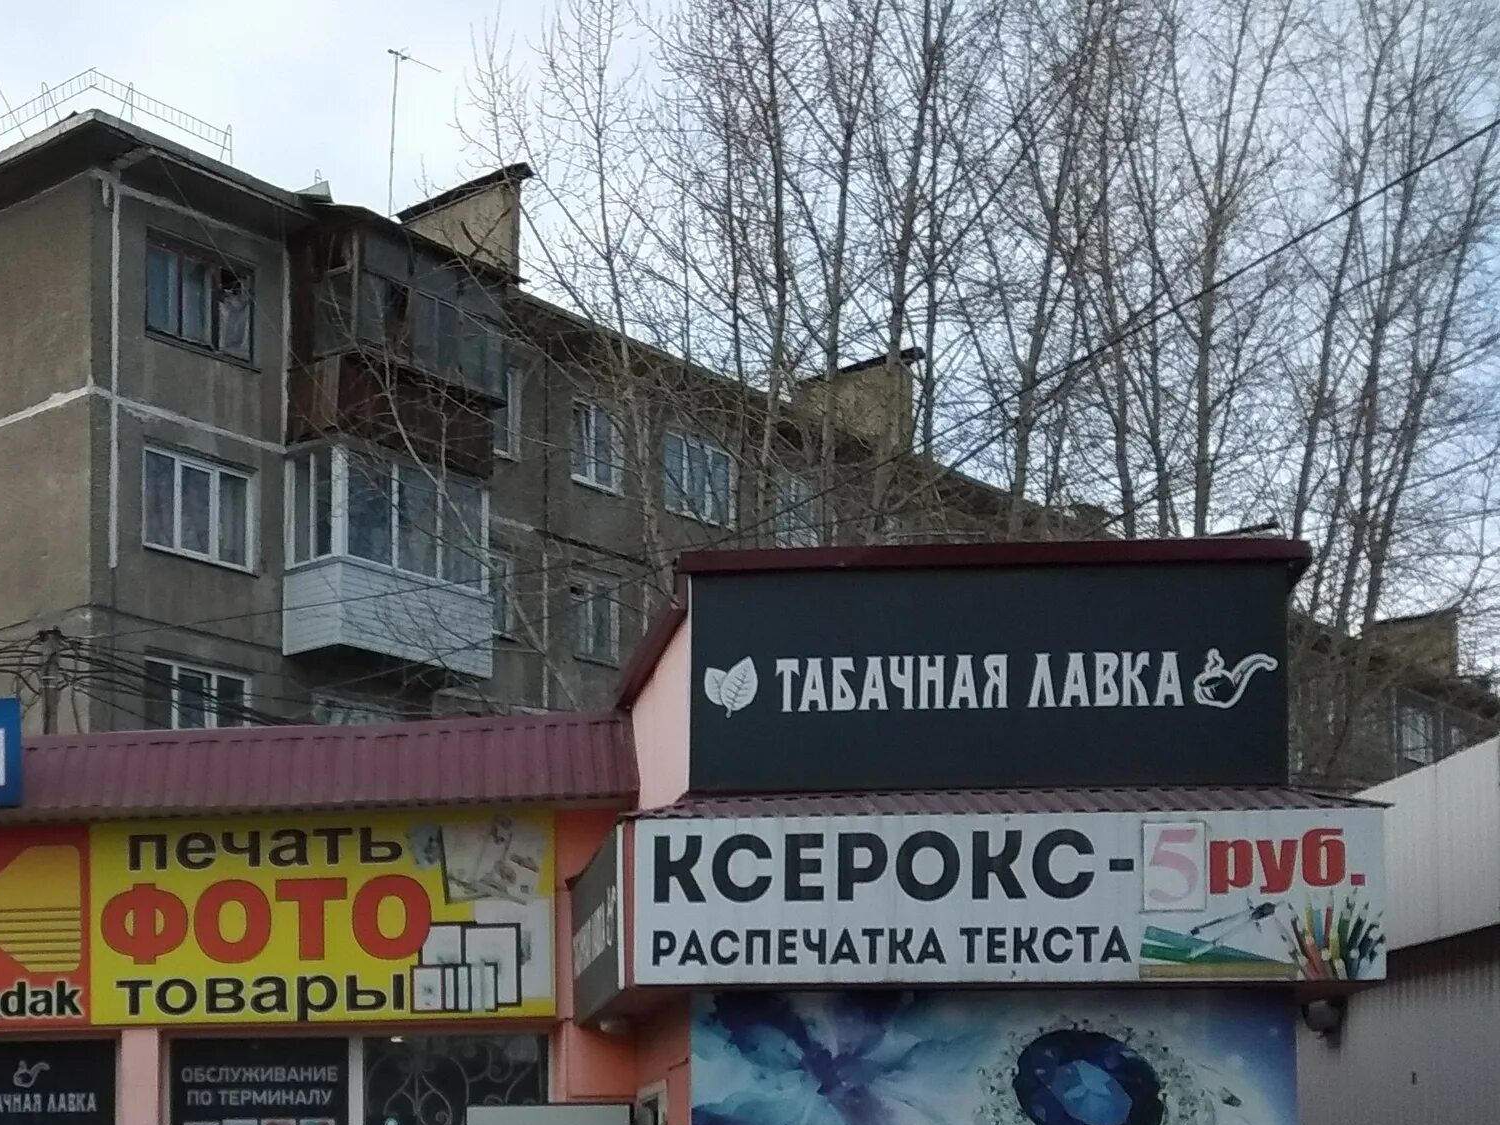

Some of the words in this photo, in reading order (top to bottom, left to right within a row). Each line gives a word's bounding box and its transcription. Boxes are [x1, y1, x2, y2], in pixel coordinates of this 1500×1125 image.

[775, 654, 1008, 713] ТАБАЧНАЯ
[1028, 651, 1184, 709] ЛАВКА
[127, 825, 404, 872] печать
[101, 873, 433, 966] ФОТО
[651, 927, 946, 967] РАСПЕЧАТКА
[960, 925, 1132, 964] ТЕКСТА
[115, 973, 407, 1023] товары
[181, 1066, 339, 1083] ОБСЛУЖИВАНИЕ
[47, 1092, 97, 1112] ЛАВКА
[186, 1090, 213, 1106] ПО
[218, 1089, 333, 1106] ТЕРМИНАЛУ
